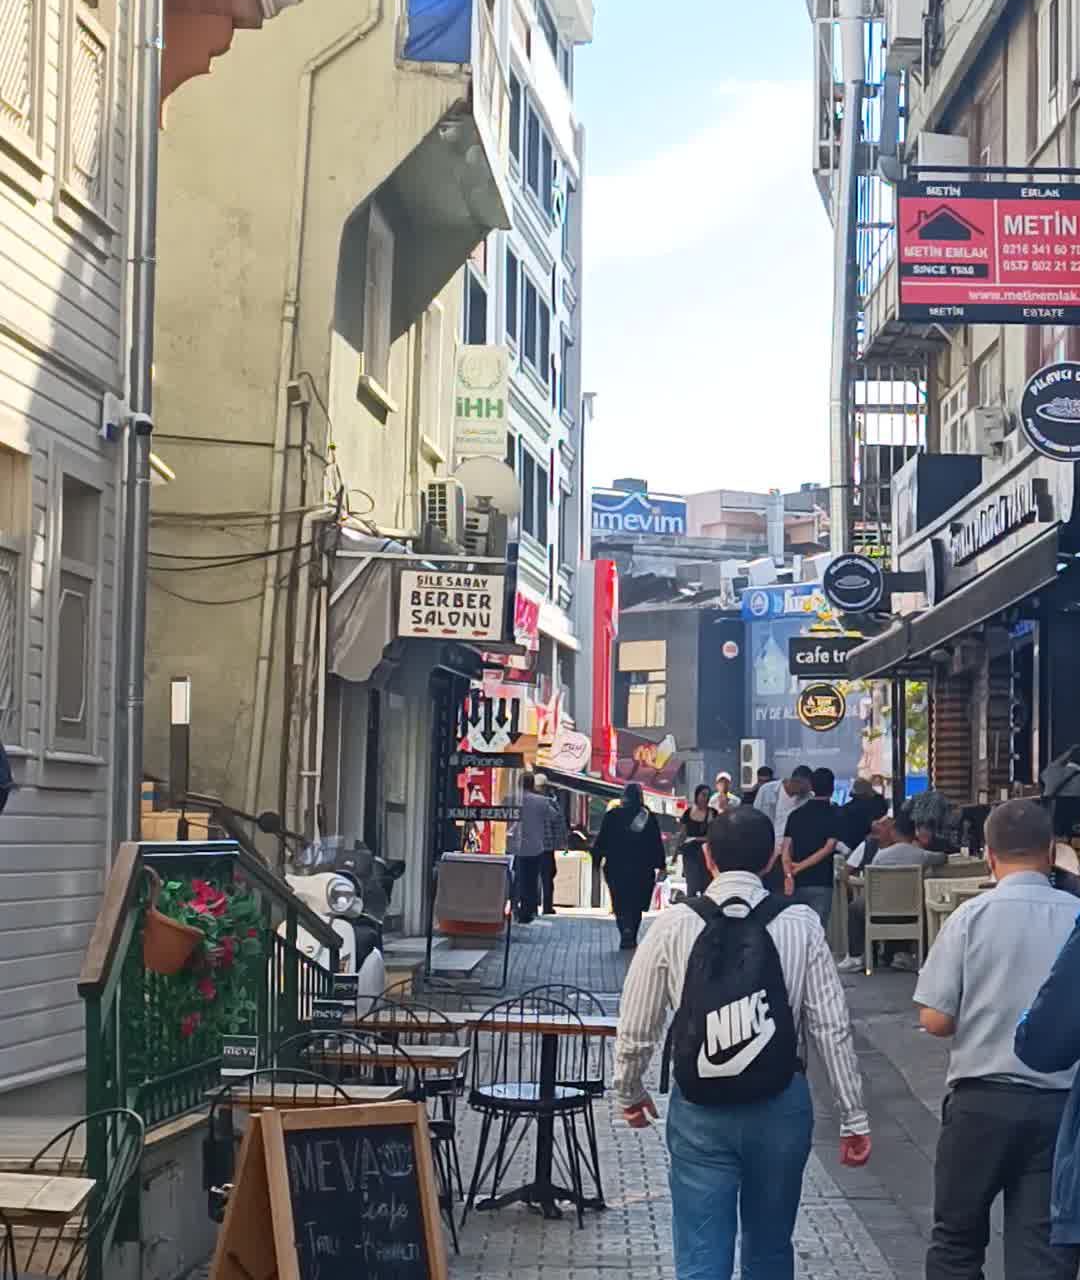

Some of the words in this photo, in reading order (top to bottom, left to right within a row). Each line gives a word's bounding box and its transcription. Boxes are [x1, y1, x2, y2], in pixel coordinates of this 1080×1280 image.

[1003, 209, 1078, 236] METİN
[410, 590, 492, 610] BERBER
[411, 609, 491, 628] SALONU
[796, 645, 829, 664] cafe
[706, 988, 777, 1057] NIKE
[288, 1137, 382, 1193] MEVA
